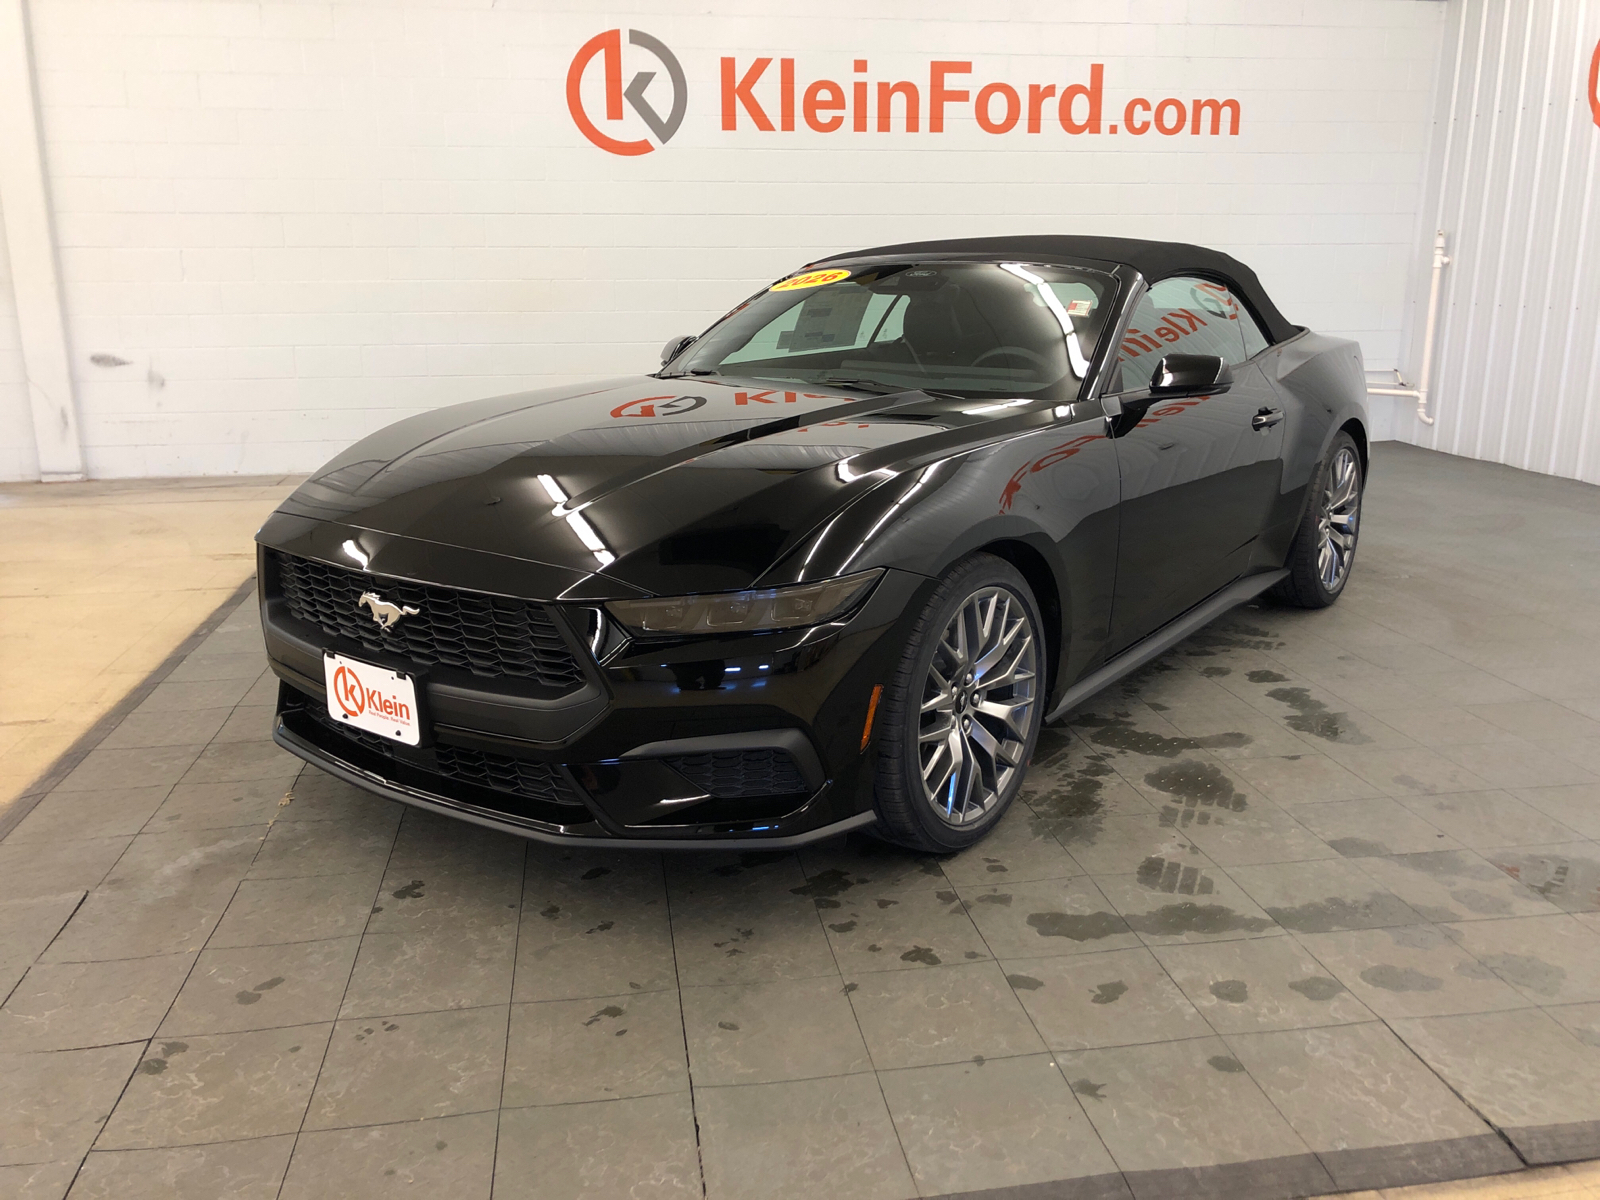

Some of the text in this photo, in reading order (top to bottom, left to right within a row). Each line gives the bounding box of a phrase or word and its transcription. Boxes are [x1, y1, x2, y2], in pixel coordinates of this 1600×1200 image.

[720, 57, 1241, 136] KleinFord.com
[775, 271, 844, 290] 2026
[366, 687, 410, 720] Klein
